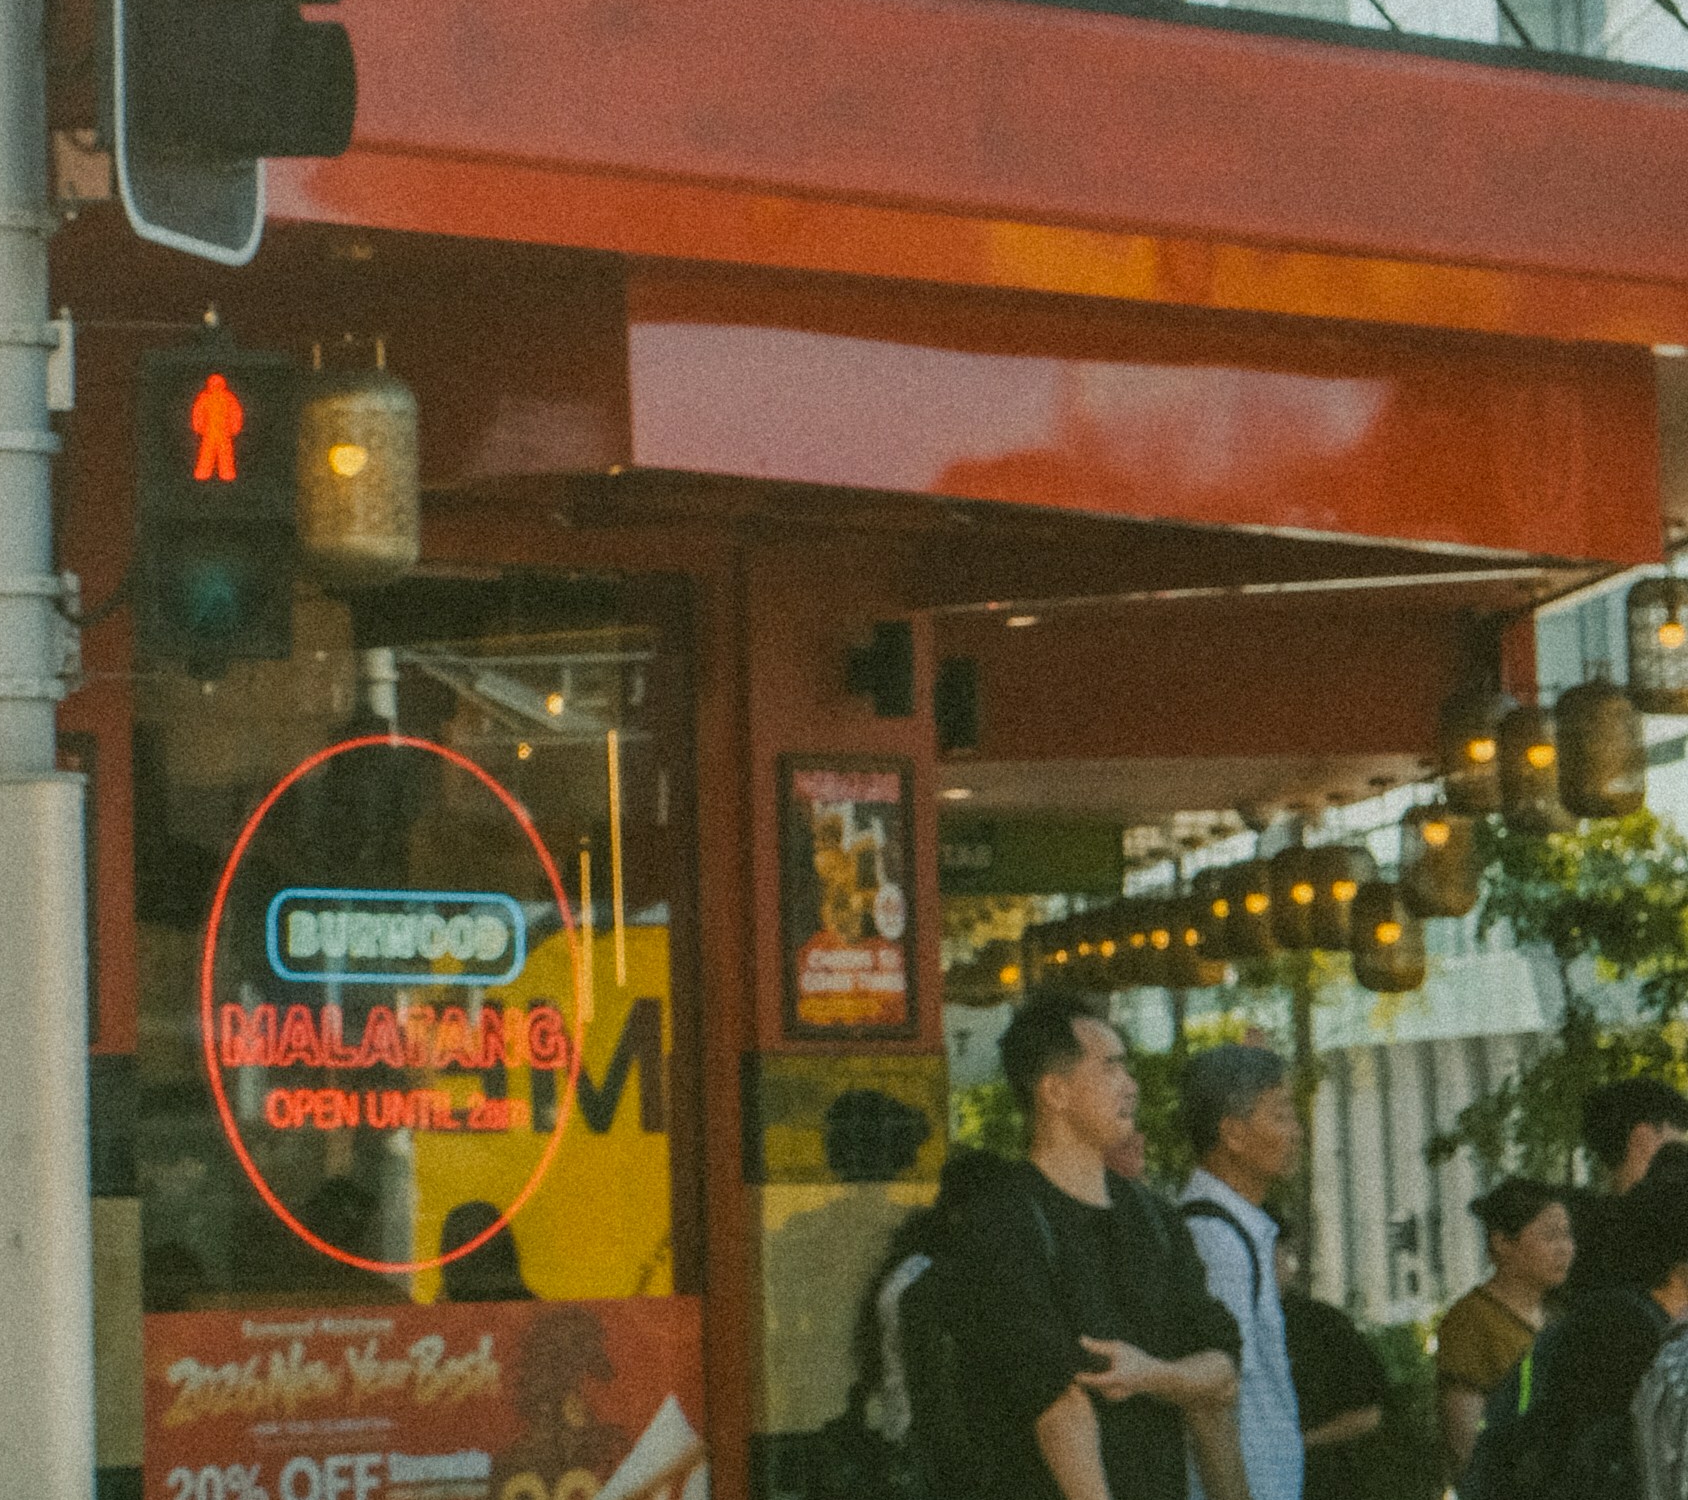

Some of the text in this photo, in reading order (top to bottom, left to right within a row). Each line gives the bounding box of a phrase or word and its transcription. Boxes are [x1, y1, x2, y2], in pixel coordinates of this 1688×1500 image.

[287, 909, 509, 962] BURWOOD
[221, 1002, 569, 1071] MALATANG
[265, 1088, 361, 1130] OPEN
[366, 1088, 462, 1130] UNTIL
